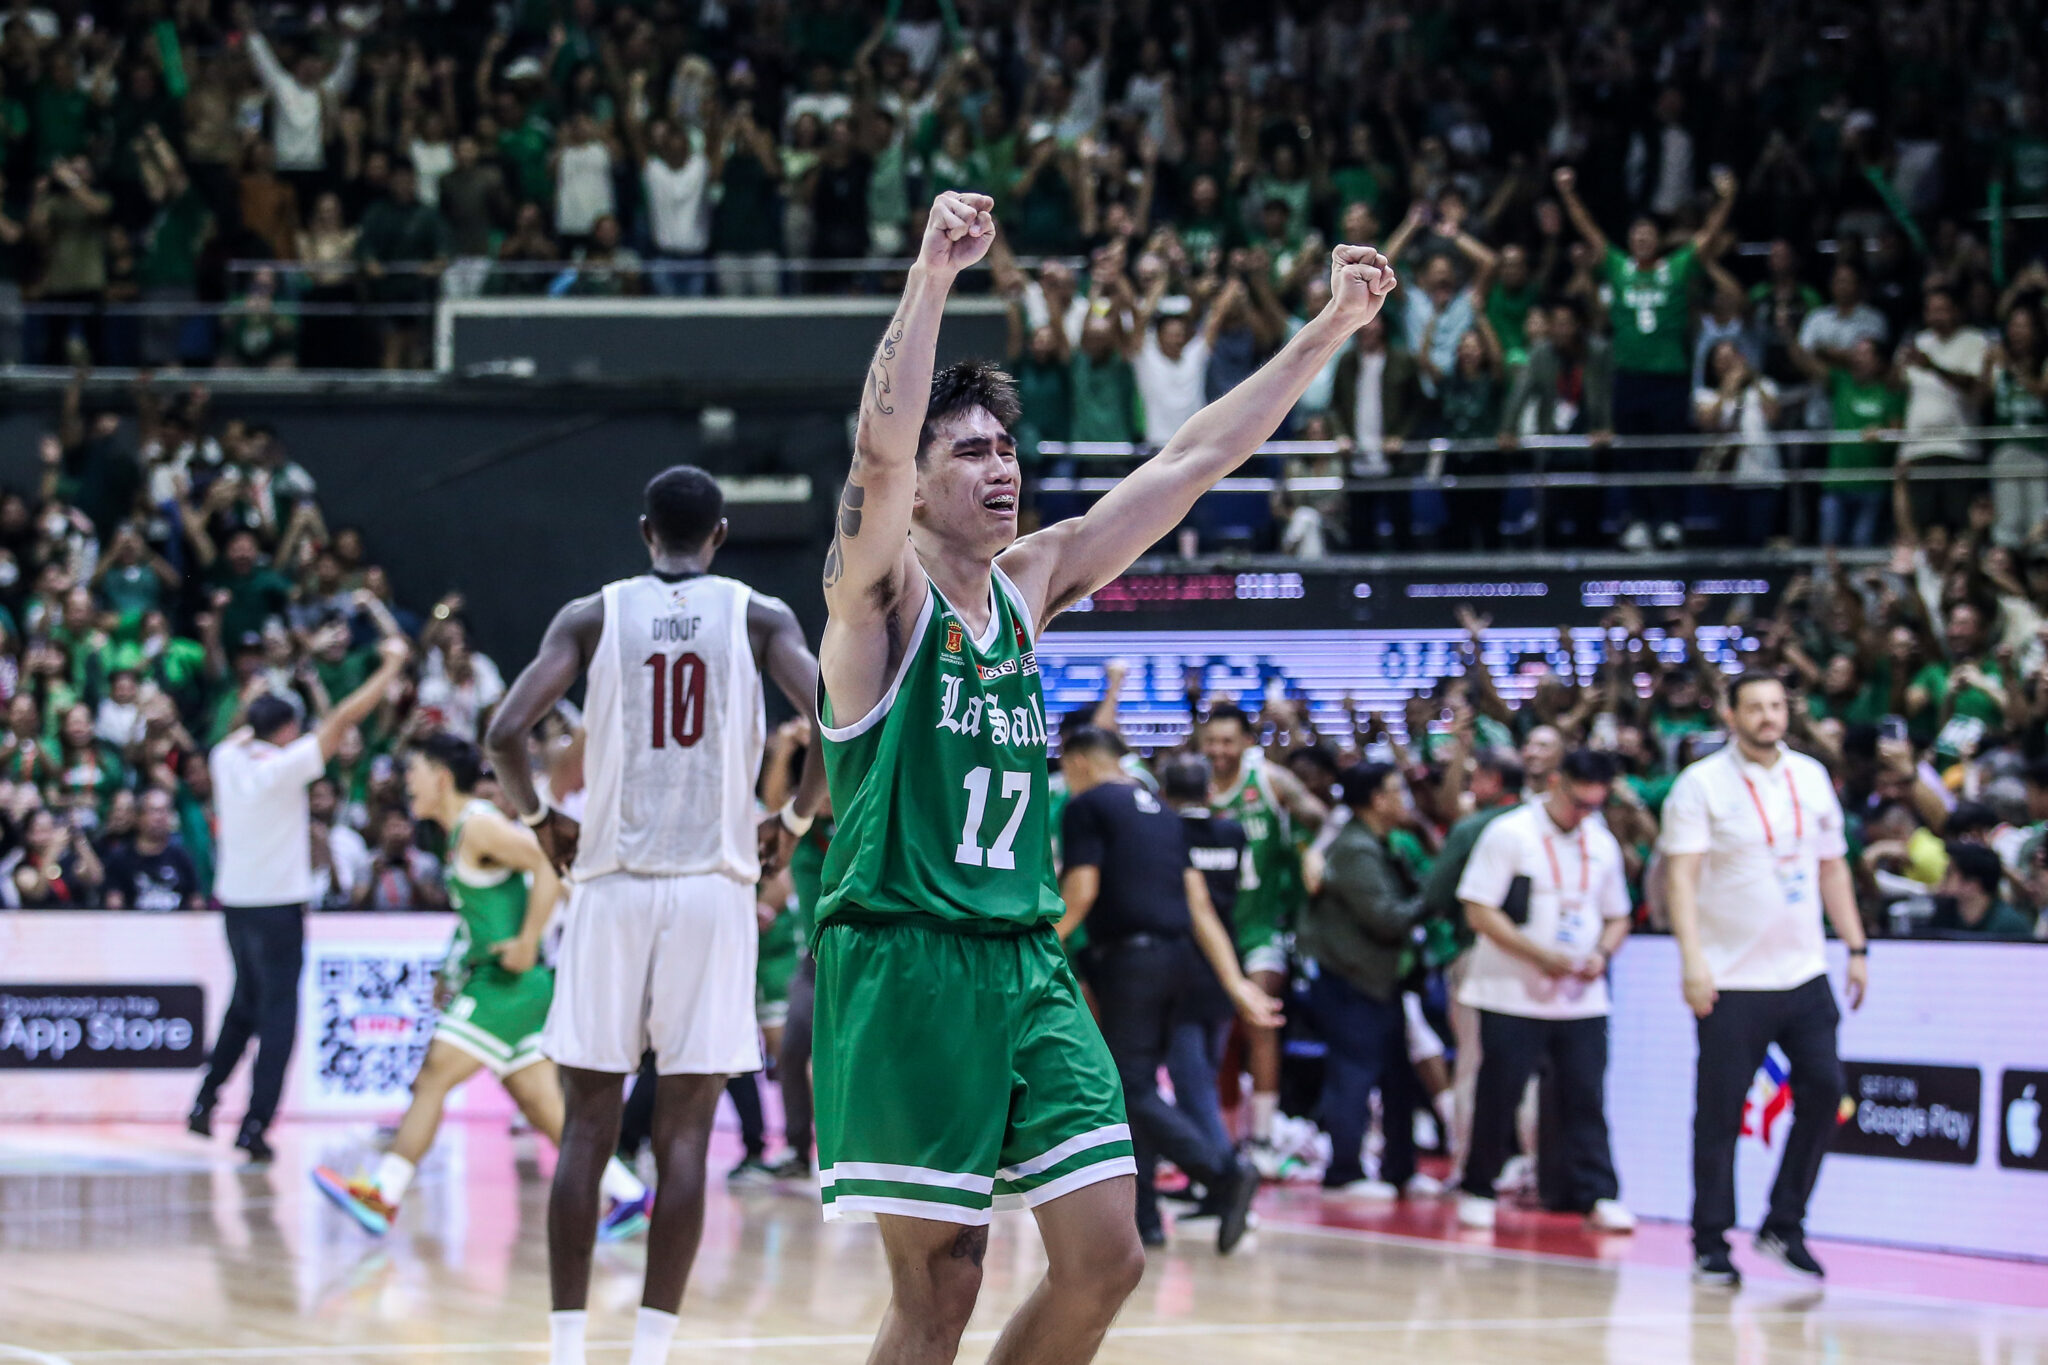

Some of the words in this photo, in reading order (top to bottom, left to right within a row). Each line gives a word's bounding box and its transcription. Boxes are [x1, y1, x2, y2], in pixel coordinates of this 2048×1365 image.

[652, 617, 702, 643] DIOUF
[982, 659, 1017, 678] ICTSI
[642, 652, 707, 750] 10
[985, 692, 1048, 748] Sall
[953, 765, 1032, 871] 17
[0, 1013, 82, 1061] App
[86, 1012, 193, 1051] Store
[1857, 1099, 1928, 1147] Google
[1929, 1103, 1974, 1150] Play
